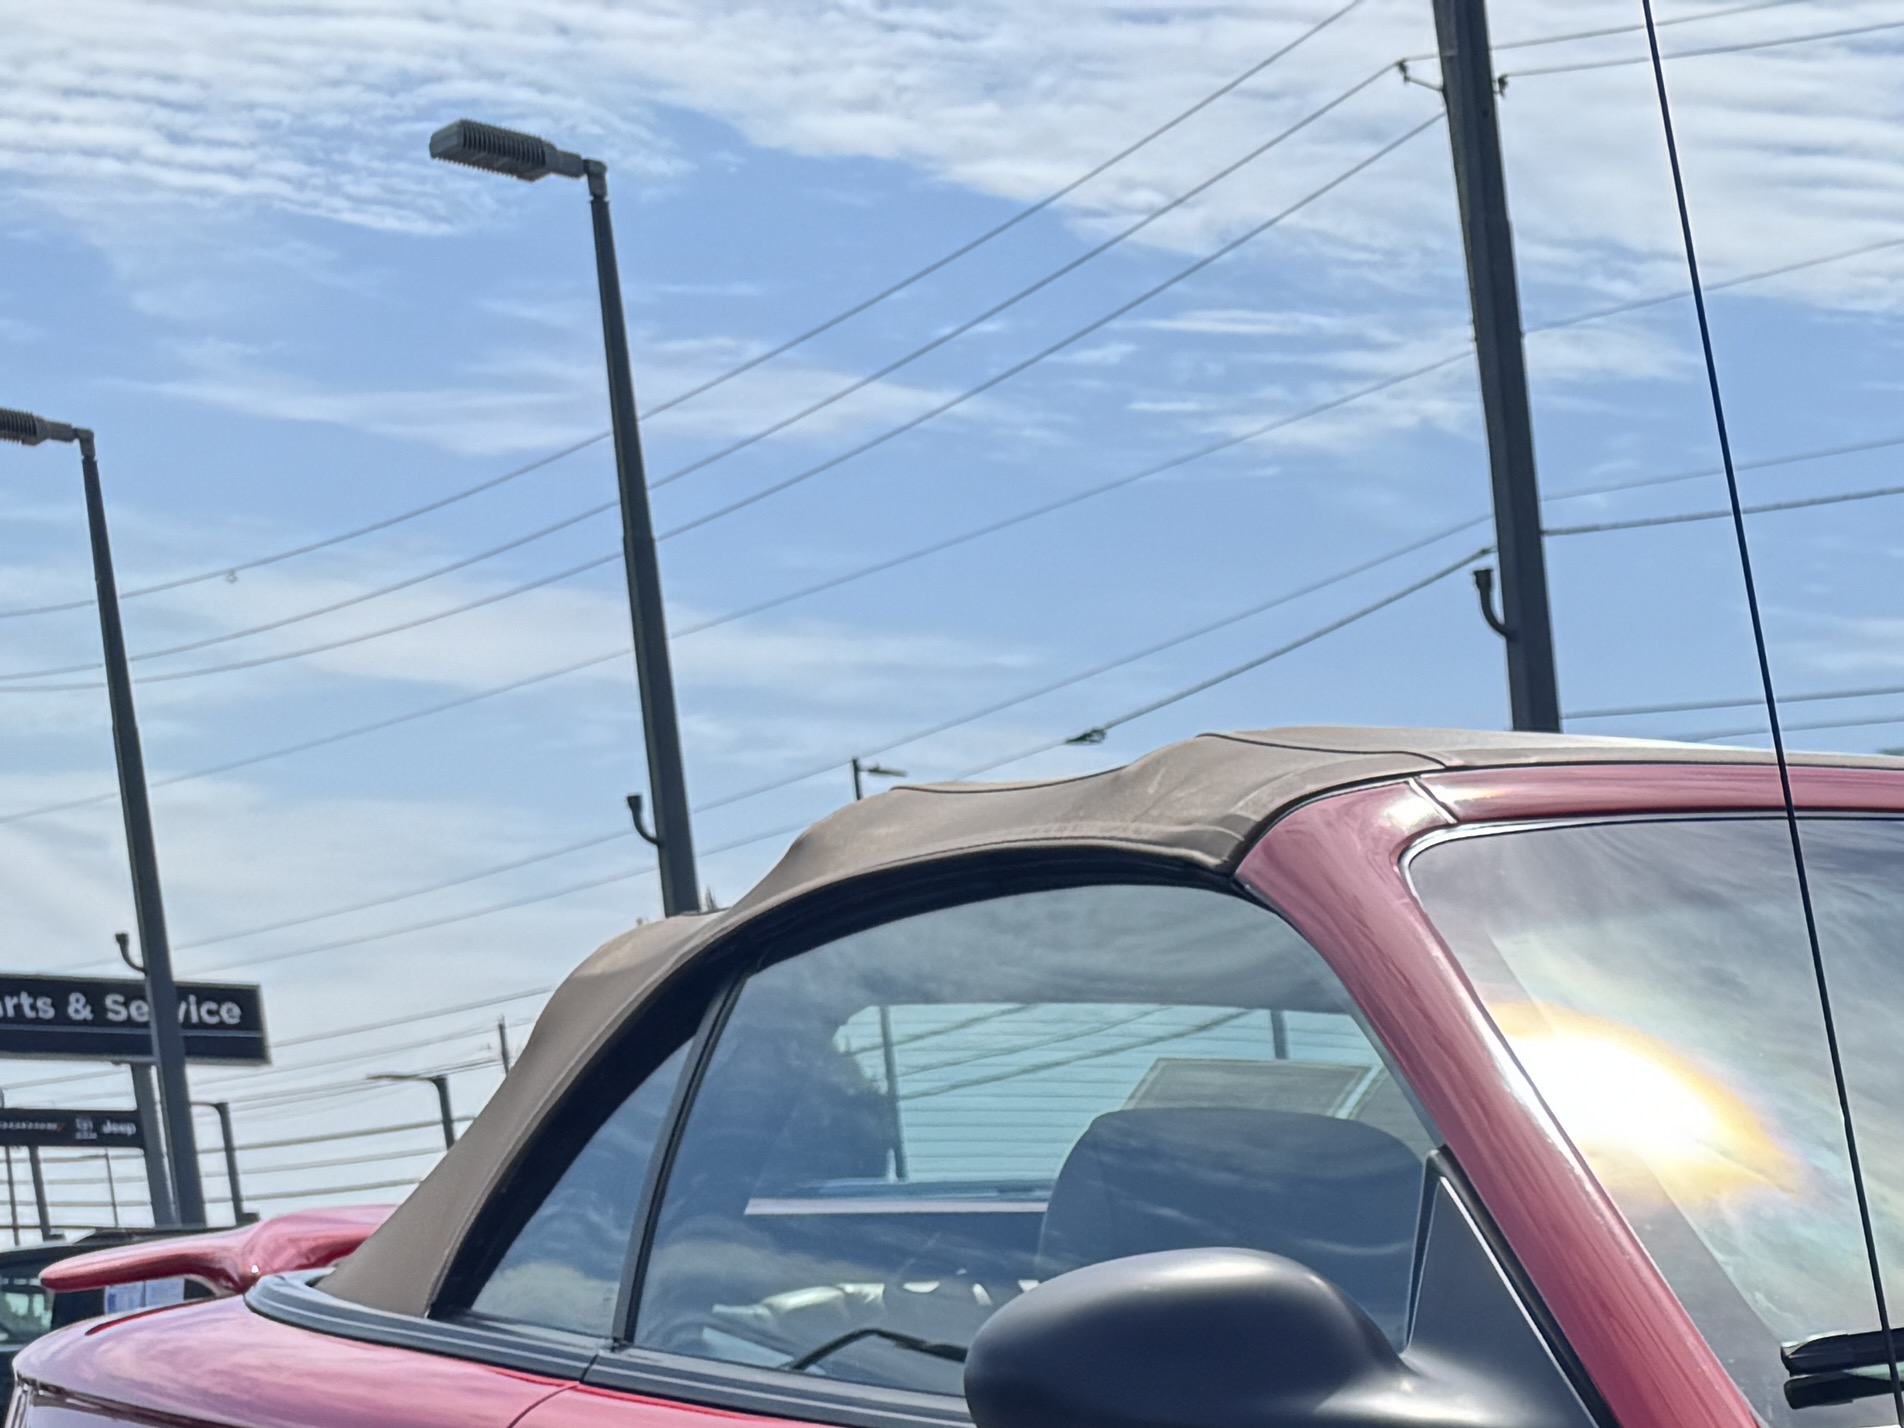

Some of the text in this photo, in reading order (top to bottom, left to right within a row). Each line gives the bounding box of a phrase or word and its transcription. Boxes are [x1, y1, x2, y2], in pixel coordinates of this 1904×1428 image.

[0, 990, 242, 1025] rts & Seice
